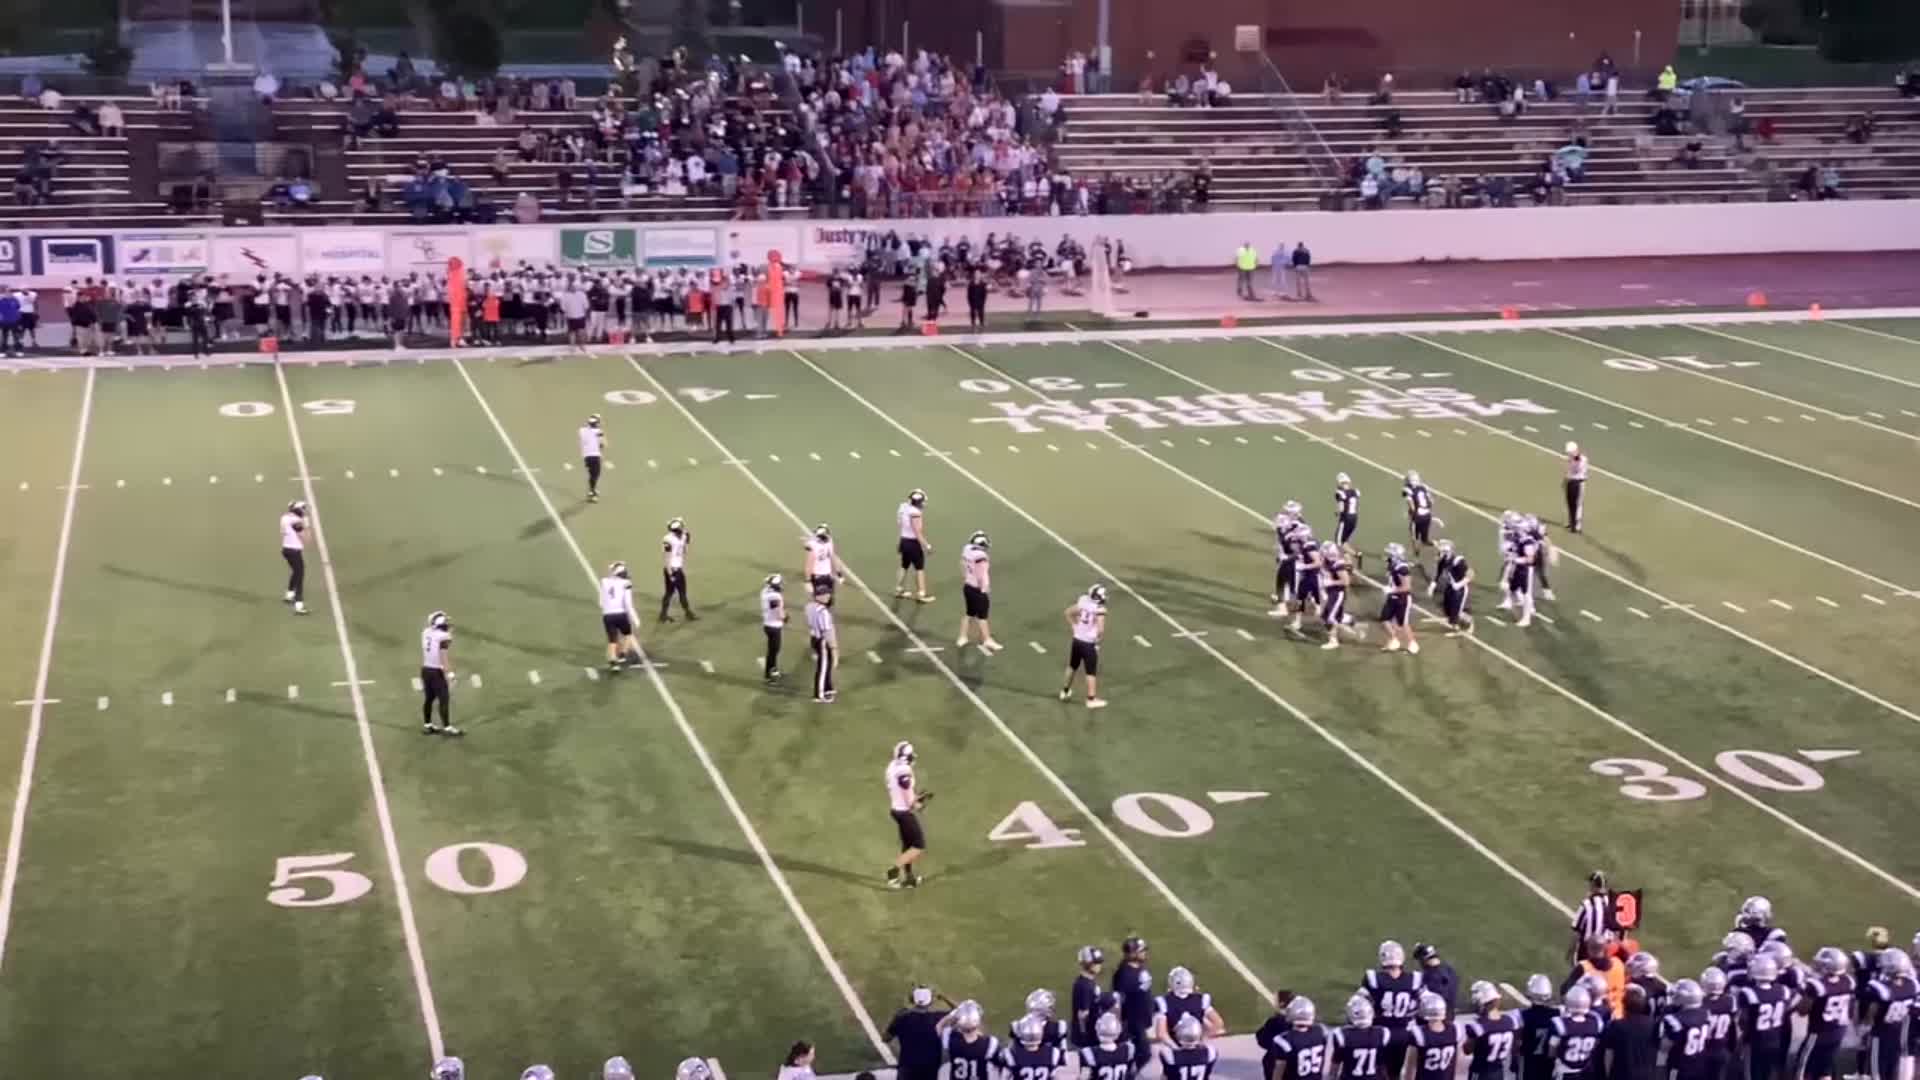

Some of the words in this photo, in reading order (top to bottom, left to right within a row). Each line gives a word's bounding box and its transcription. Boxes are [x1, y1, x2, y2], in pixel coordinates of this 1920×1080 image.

[969, 399, 1558, 433] MEMORIAL
[988, 387, 1475, 416] STADIUM
[1615, 893, 1636, 929] 3
[1381, 991, 1411, 1017] 40
[1297, 1045, 1324, 1077] 65
[1352, 1048, 1377, 1077] 71
[1424, 1046, 1456, 1071] 20
